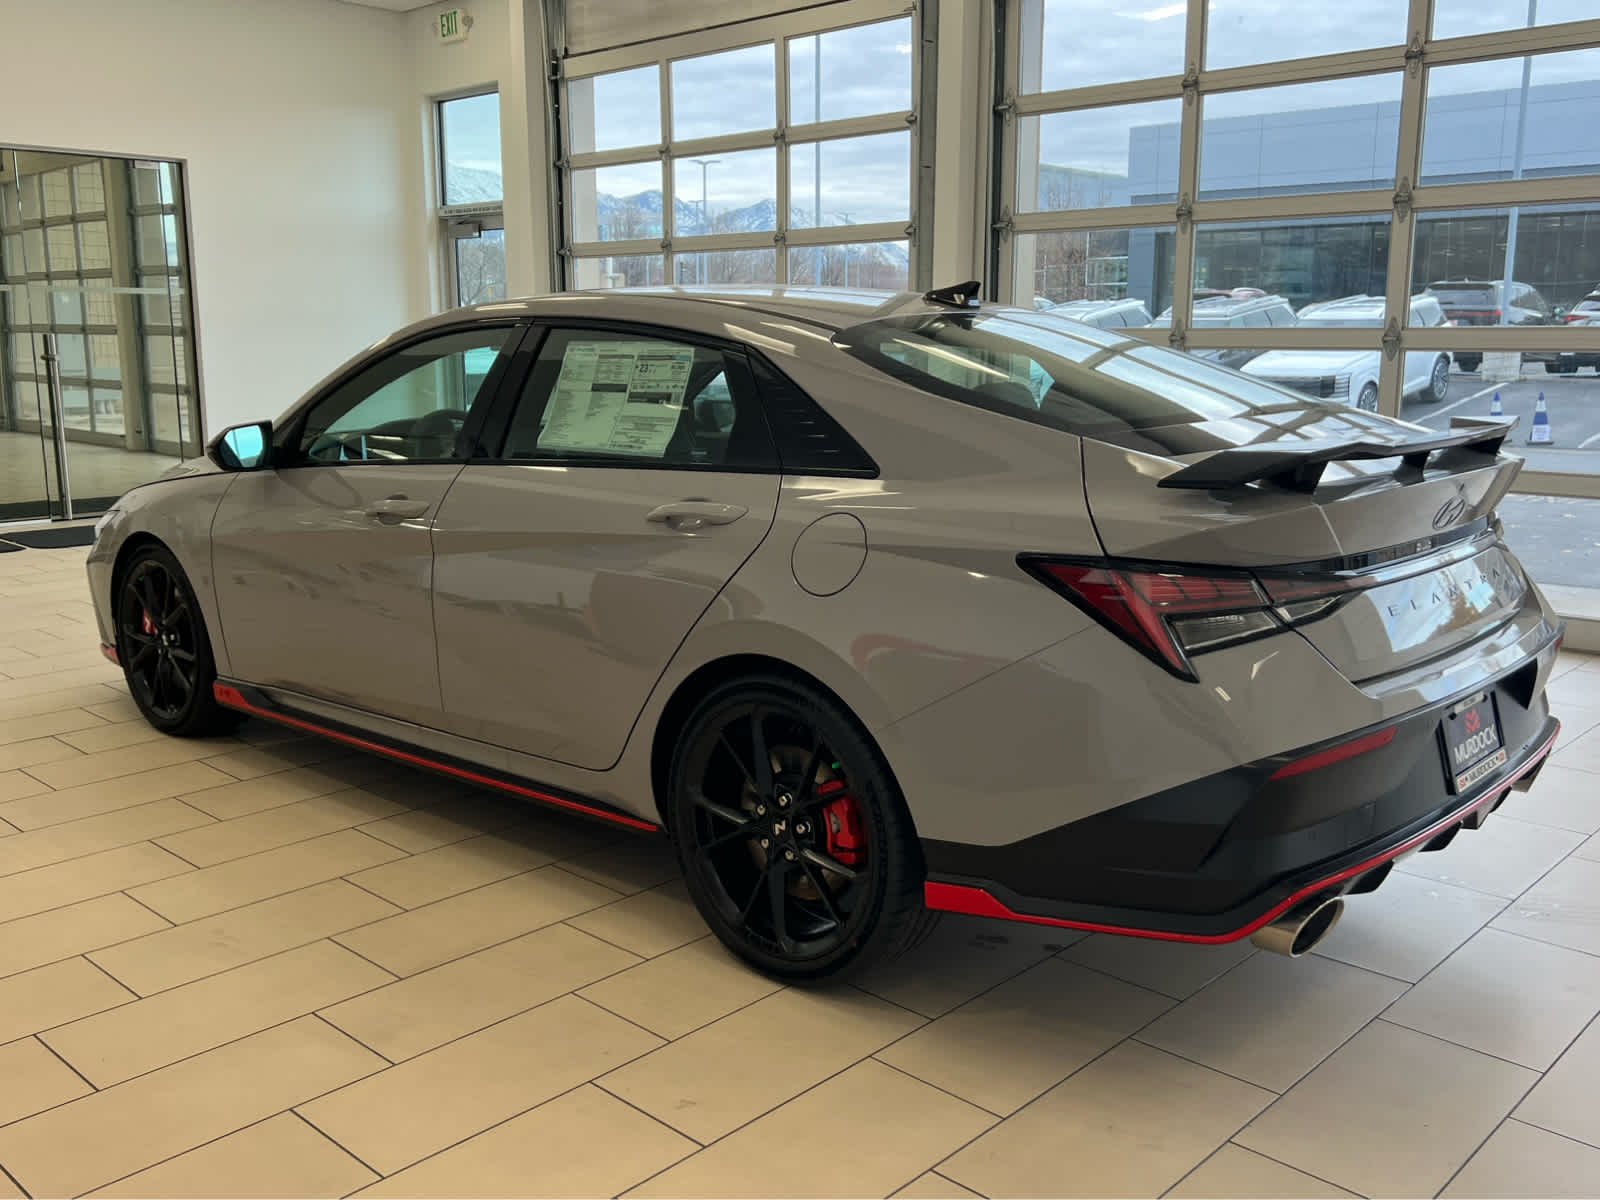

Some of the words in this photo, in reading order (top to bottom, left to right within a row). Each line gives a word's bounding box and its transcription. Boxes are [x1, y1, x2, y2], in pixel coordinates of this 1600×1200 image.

[440, 11, 458, 37] EXIT
[1387, 567, 1501, 617] ELANTRA
[1454, 724, 1497, 764] MURDOCK
